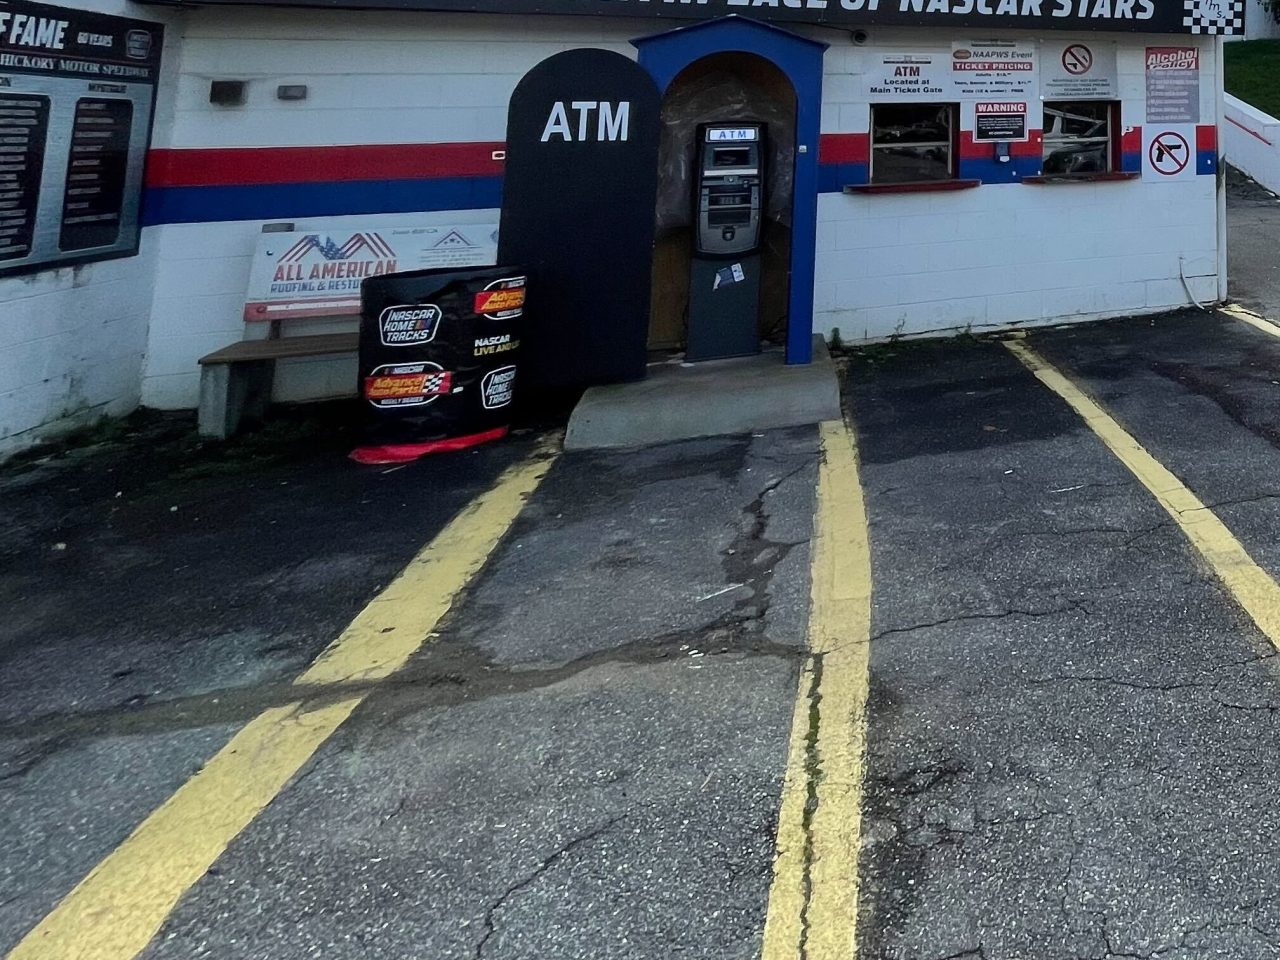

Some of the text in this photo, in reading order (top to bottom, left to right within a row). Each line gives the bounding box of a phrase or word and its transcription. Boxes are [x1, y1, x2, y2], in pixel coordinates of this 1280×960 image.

[9, 14, 70, 50] FAME
[88, 32, 114, 47] YEARS
[1011, 50, 1033, 59] Event
[1147, 47, 1198, 66] Alcohol
[0, 52, 55, 70] HICKORY
[58, 59, 101, 74] MOTOR
[955, 62, 1031, 71] TICKET PRICING
[894, 66, 920, 77] ATM
[884, 78, 930, 86] Located at
[894, 86, 921, 94] Ticket
[922, 86, 943, 94] Gate
[977, 103, 1025, 113] WARNING
[540, 100, 631, 143] ATM
[719, 130, 747, 139] ATM
[273, 259, 397, 282] ALL AMERICAN
[270, 278, 361, 294] ROOFING & RESTO
[391, 308, 436, 321] NASCAR
[383, 320, 415, 332] HOME
[386, 329, 430, 342] TRACKS
[474, 334, 511, 347] NASCAR
[473, 346, 494, 357] LIVE
[373, 376, 423, 388] Advance
